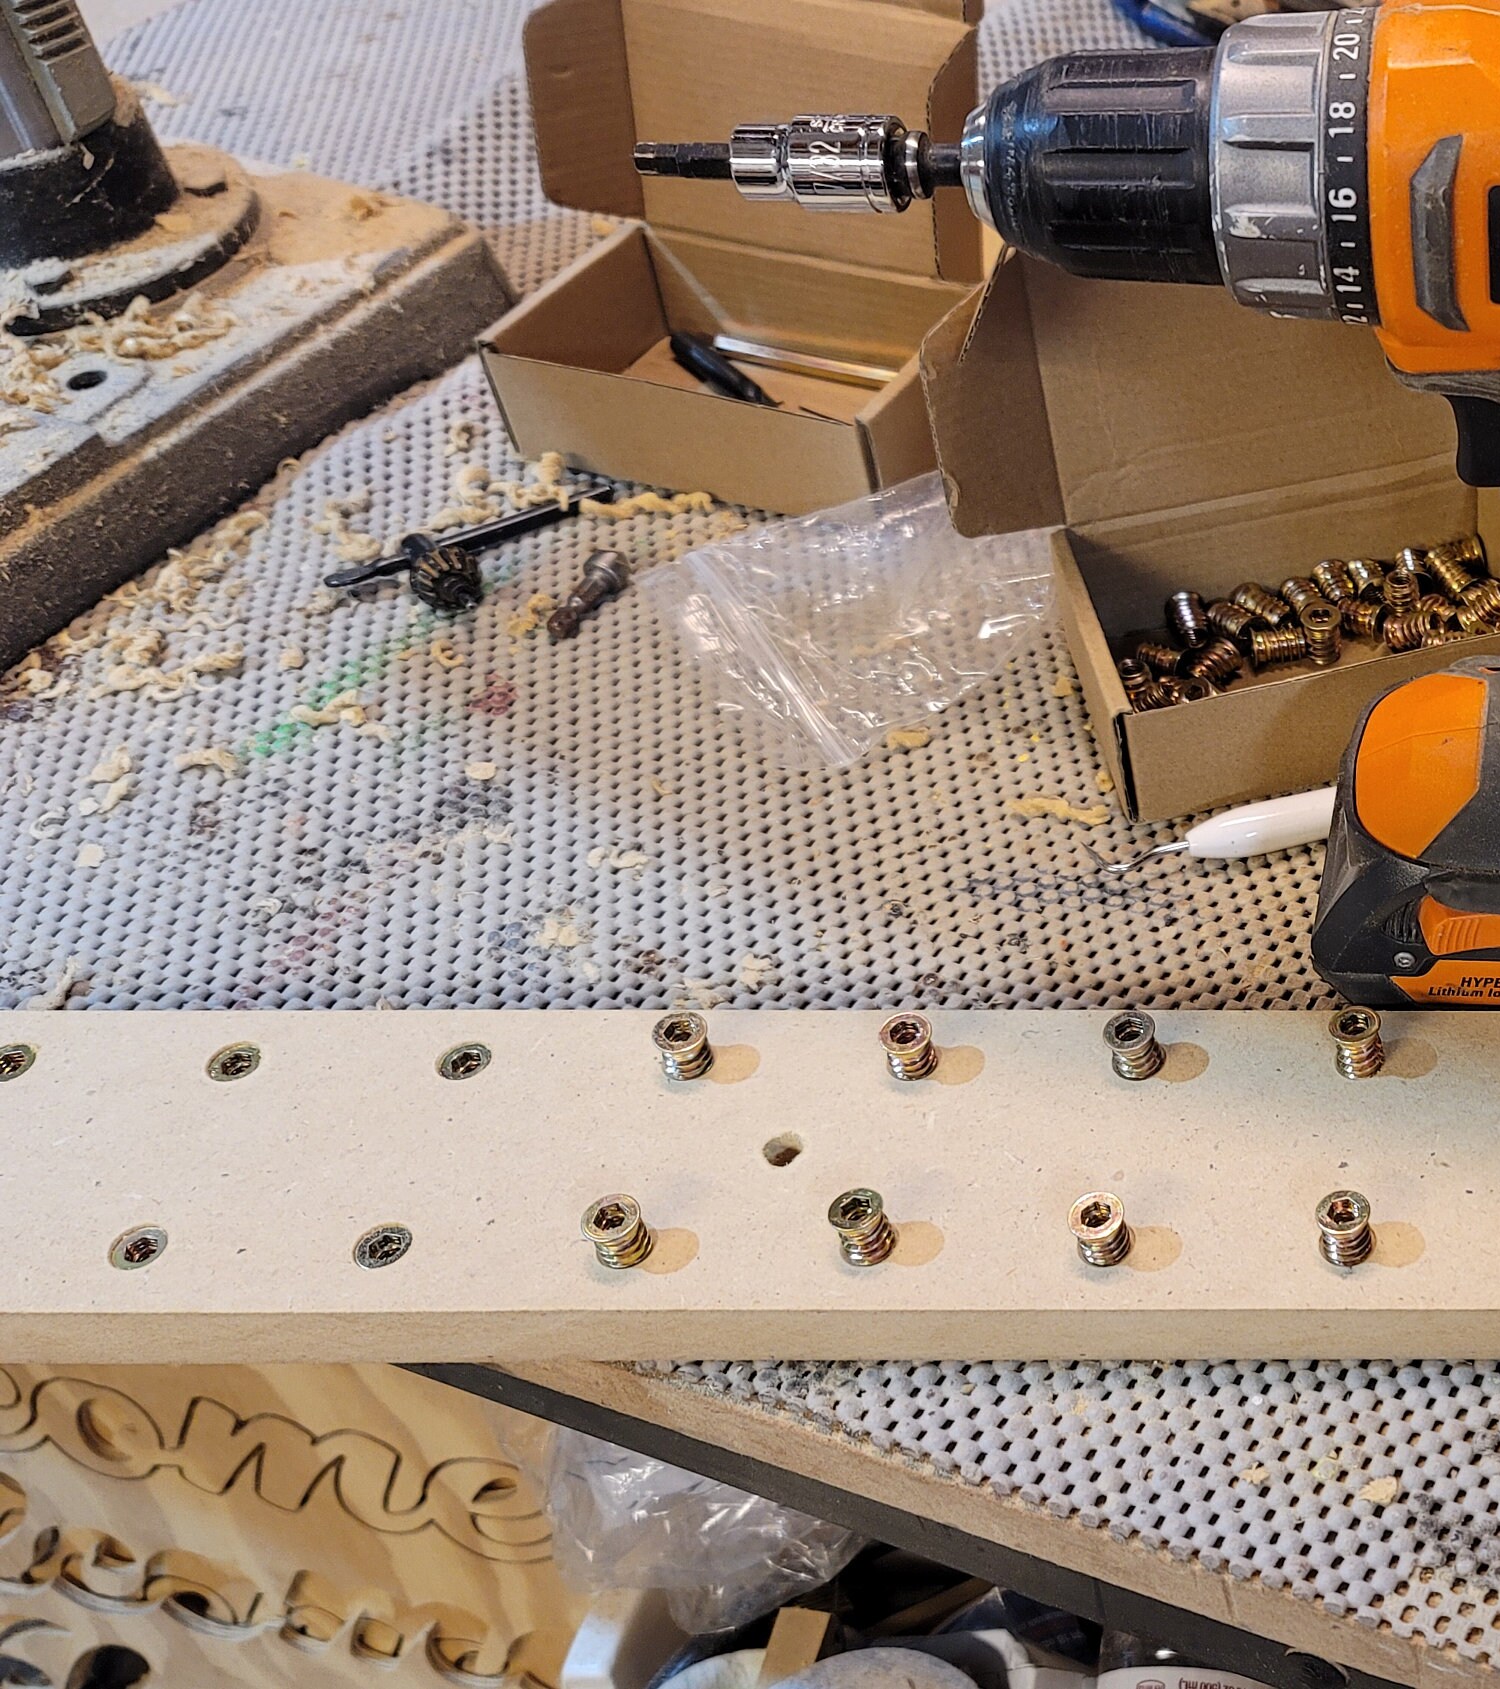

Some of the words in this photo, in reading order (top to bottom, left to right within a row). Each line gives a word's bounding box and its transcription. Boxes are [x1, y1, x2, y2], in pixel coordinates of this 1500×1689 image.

[1333, 33, 1360, 60] 20
[1328, 101, 1356, 138] 18
[1328, 187, 1357, 222] 16
[1333, 266, 1362, 293] 14
[1428, 986, 1484, 997] Lithium
